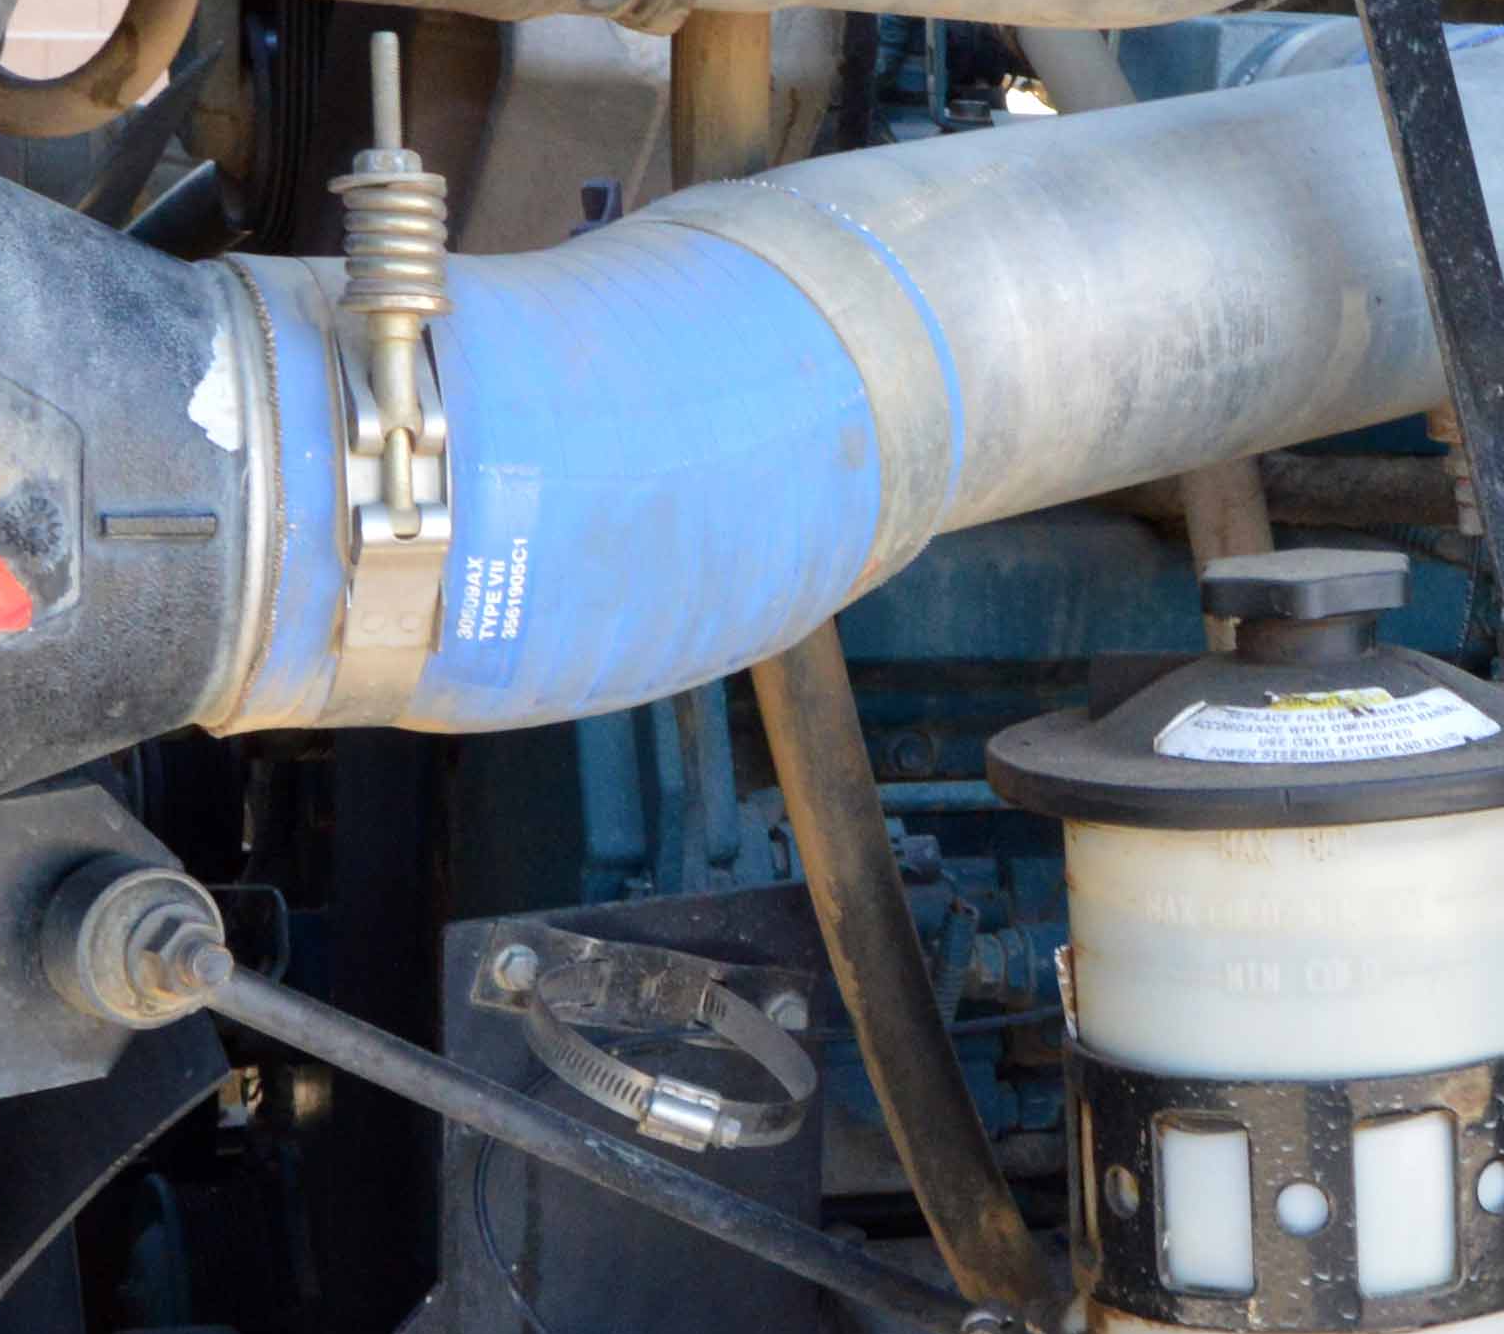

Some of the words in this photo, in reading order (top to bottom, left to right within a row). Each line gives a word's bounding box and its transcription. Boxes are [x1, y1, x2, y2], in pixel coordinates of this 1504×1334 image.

[488, 559, 506, 588] VII
[479, 589, 503, 641] TYPE
[1209, 747, 1256, 758] POWER
[1262, 749, 1336, 760] STEERING
[1341, 745, 1390, 757] FILTER
[1394, 740, 1422, 753] AND
[1292, 737, 1329, 747] ONLY
[1337, 729, 1413, 745] APPROVED
